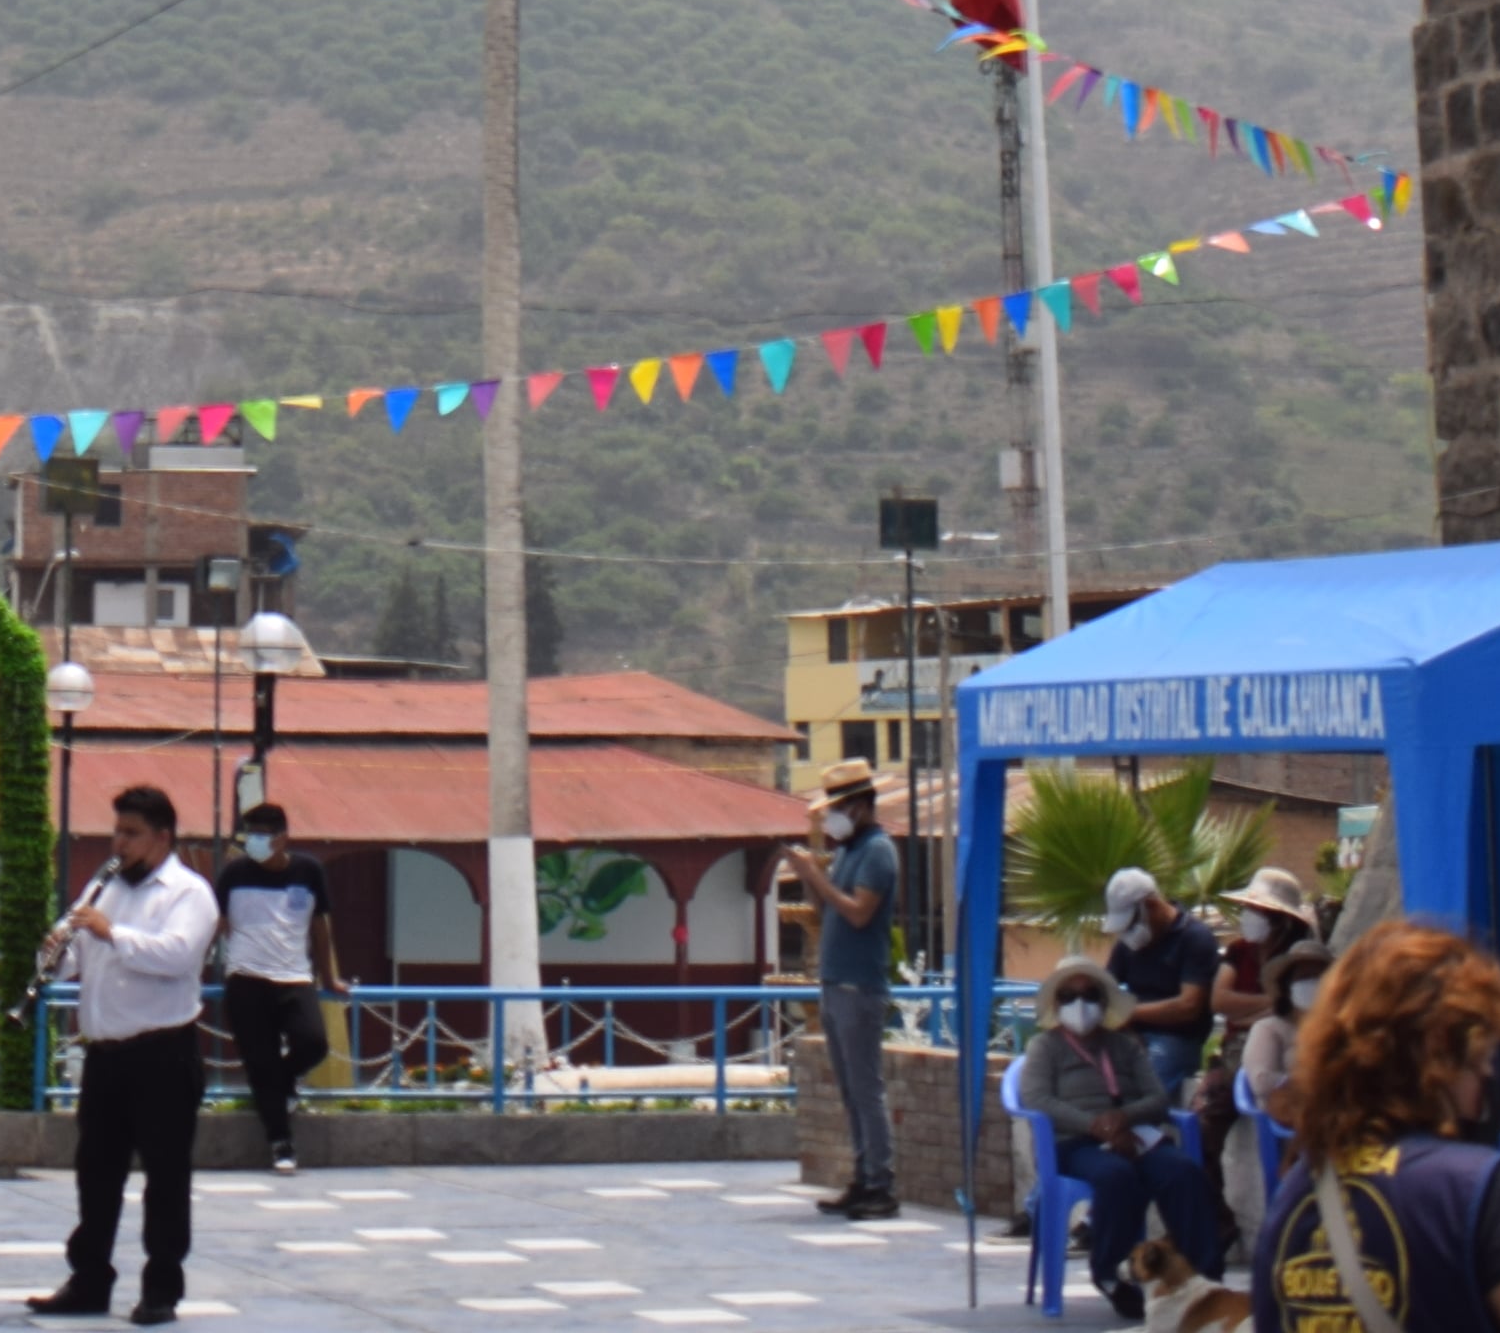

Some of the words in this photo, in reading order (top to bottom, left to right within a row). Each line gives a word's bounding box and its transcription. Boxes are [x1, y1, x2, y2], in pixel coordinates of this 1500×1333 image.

[979, 685, 1110, 746] MUNICIPALIDAD
[1114, 679, 1199, 741] DISTRITAL
[1206, 676, 1231, 737] DE
[1238, 673, 1385, 740] CALLAHUANCA
